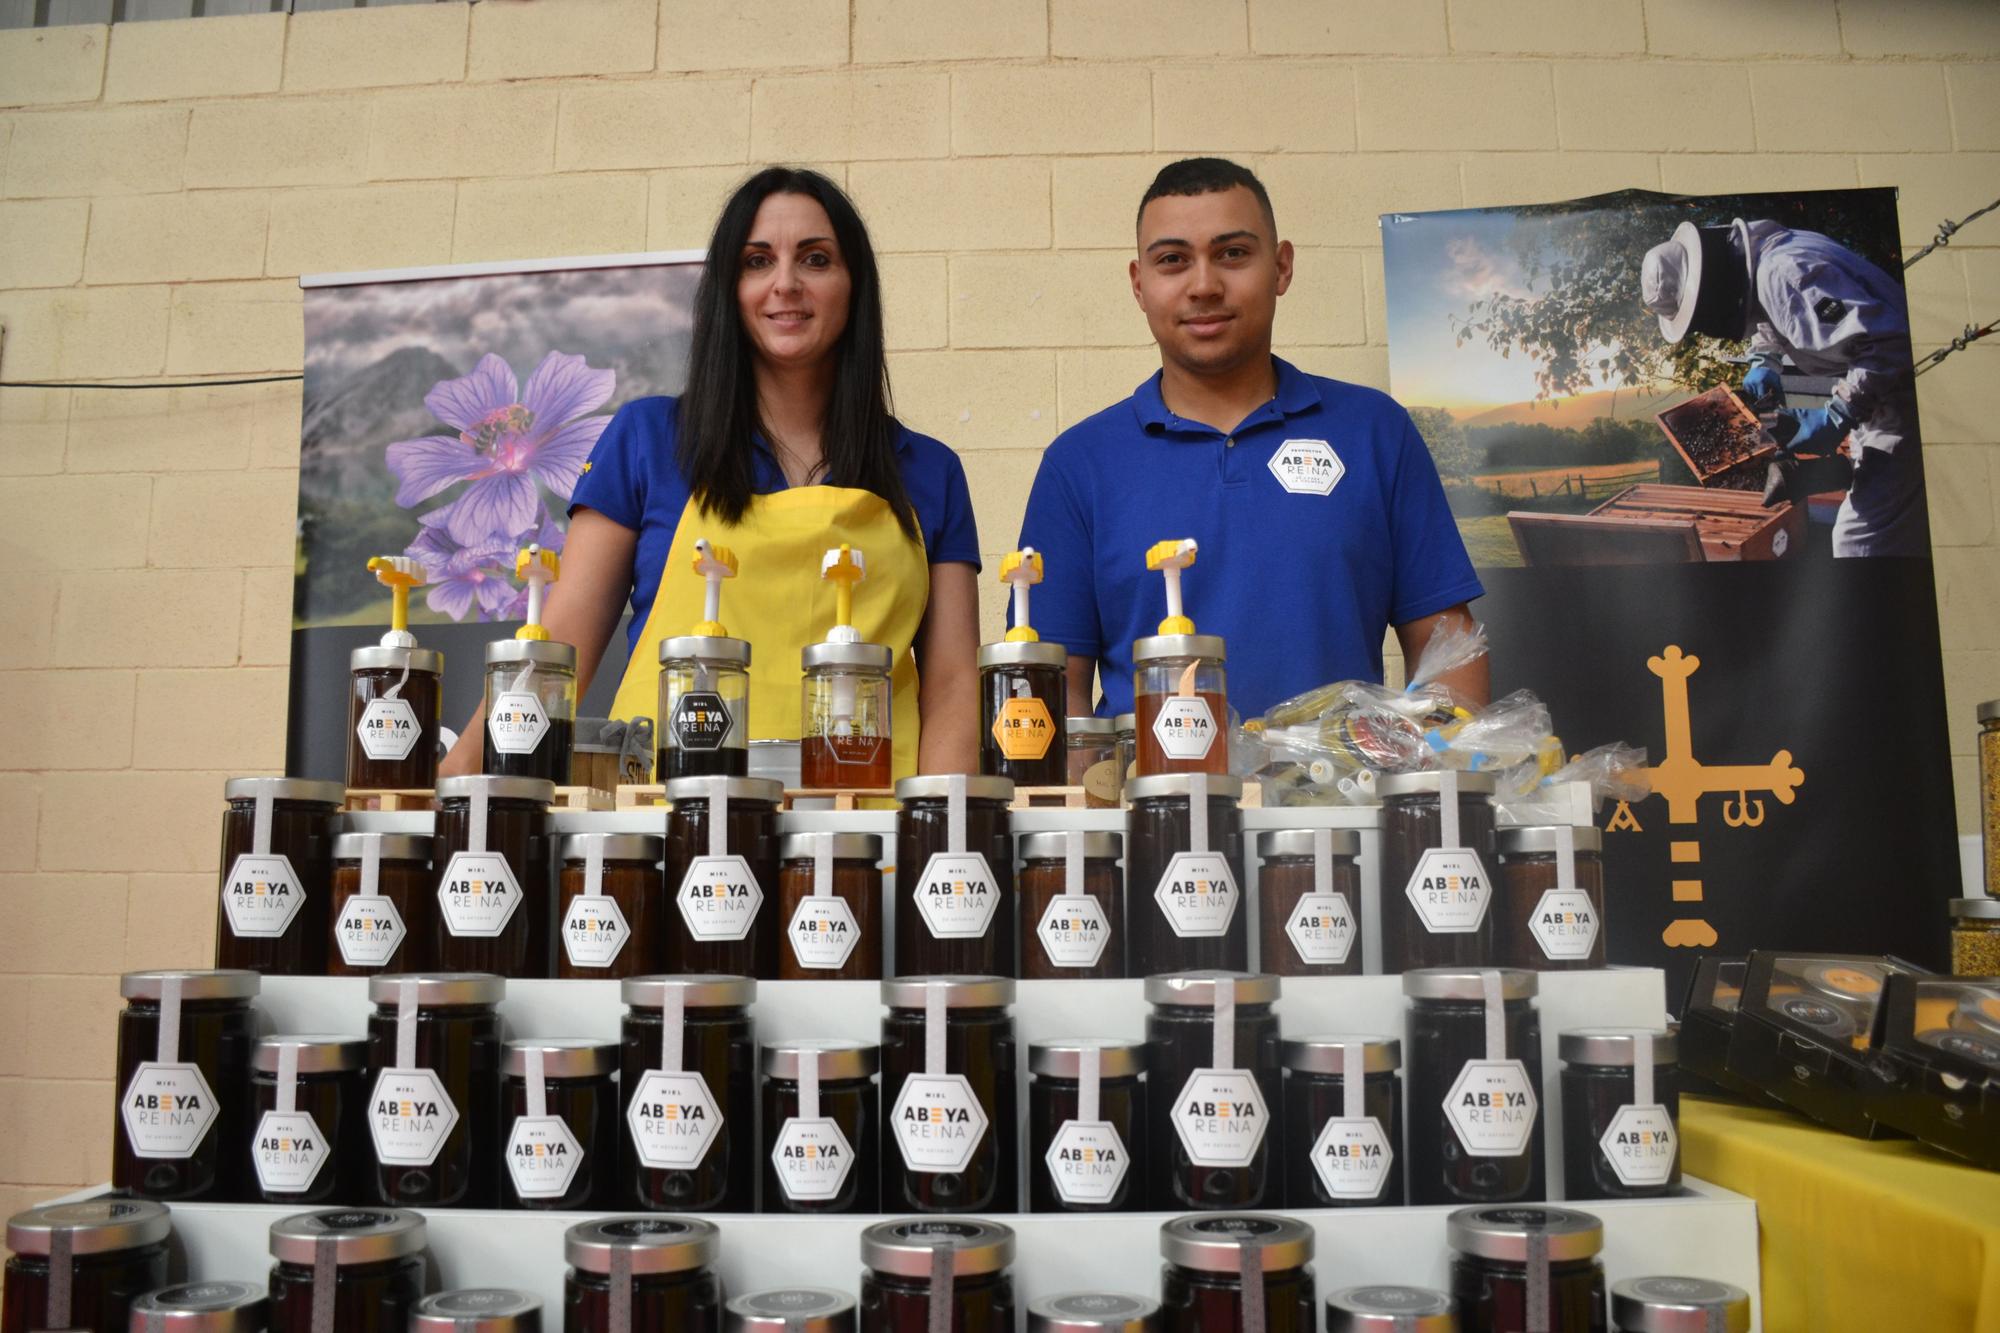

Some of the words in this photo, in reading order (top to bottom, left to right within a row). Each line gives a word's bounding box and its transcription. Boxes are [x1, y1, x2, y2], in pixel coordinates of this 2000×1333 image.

[1282, 457, 1332, 468] ABEYA
[1288, 466, 1329, 476] REINA
[496, 713, 538, 723] ABEYA
[678, 711, 723, 723] ABEYA
[1004, 718, 1046, 728] ABEYA
[1164, 718, 1208, 728] ABEYA
[367, 719, 410, 729] ABEYA
[499, 723, 534, 732] REINA
[683, 723, 720, 732] REINA
[371, 729, 407, 738] REINA
[1169, 728, 1205, 738] REINA
[837, 735, 874, 746] RENA
[234, 881, 290, 896] ABEYA
[450, 880, 506, 894] ABEYA
[929, 881, 987, 895] ABEYA
[1171, 880, 1228, 894] ABEYA
[1422, 876, 1480, 890] ABEYA
[691, 884, 749, 897] ABEYA
[237, 896, 286, 908] REINA
[454, 895, 502, 908] REINA
[935, 896, 984, 909] REINA
[1178, 895, 1225, 908] REINA
[1429, 891, 1477, 904] REINA
[696, 899, 746, 912] REINA
[345, 918, 392, 931] ABEYA
[570, 919, 616, 931] ABEYA
[1050, 919, 1100, 931] ABEYA
[1299, 916, 1347, 928] ABEYA
[1543, 913, 1590, 924] ABEYA
[799, 920, 847, 932] ABEYA
[1548, 924, 1588, 936] REINA
[348, 930, 389, 942] REINA
[573, 932, 612, 943] REINA
[802, 933, 844, 944] REINA
[1055, 931, 1097, 942] REINA
[1305, 928, 1345, 940] REINA
[134, 1095, 200, 1110] ABEYA
[1462, 1092, 1526, 1108] ABEYA
[378, 1101, 439, 1116] ABEYA
[640, 1103, 705, 1120] ABEYA
[904, 1107, 970, 1123] ABEYA
[1188, 1102, 1255, 1117] ABEYA
[139, 1111, 195, 1126] REINA
[1470, 1109, 1523, 1123] REINA
[382, 1117, 434, 1132] REINA
[645, 1119, 700, 1136] REINA
[910, 1123, 965, 1139] REINA
[1195, 1118, 1251, 1134] REINA
[1616, 1131, 1669, 1144] ABEYA
[261, 1138, 313, 1151] ABEYA
[515, 1143, 567, 1157] ABEYA
[784, 1144, 839, 1158] ABEYA
[1325, 1145, 1381, 1157] ABEYA
[1624, 1144, 1667, 1158] REINA
[265, 1152, 309, 1164] REINA
[1059, 1148, 1116, 1162] ABEYA
[520, 1156, 564, 1170] REINA
[789, 1158, 837, 1171] REINA
[1065, 1162, 1112, 1176] REINA
[1332, 1158, 1378, 1171] REINA
